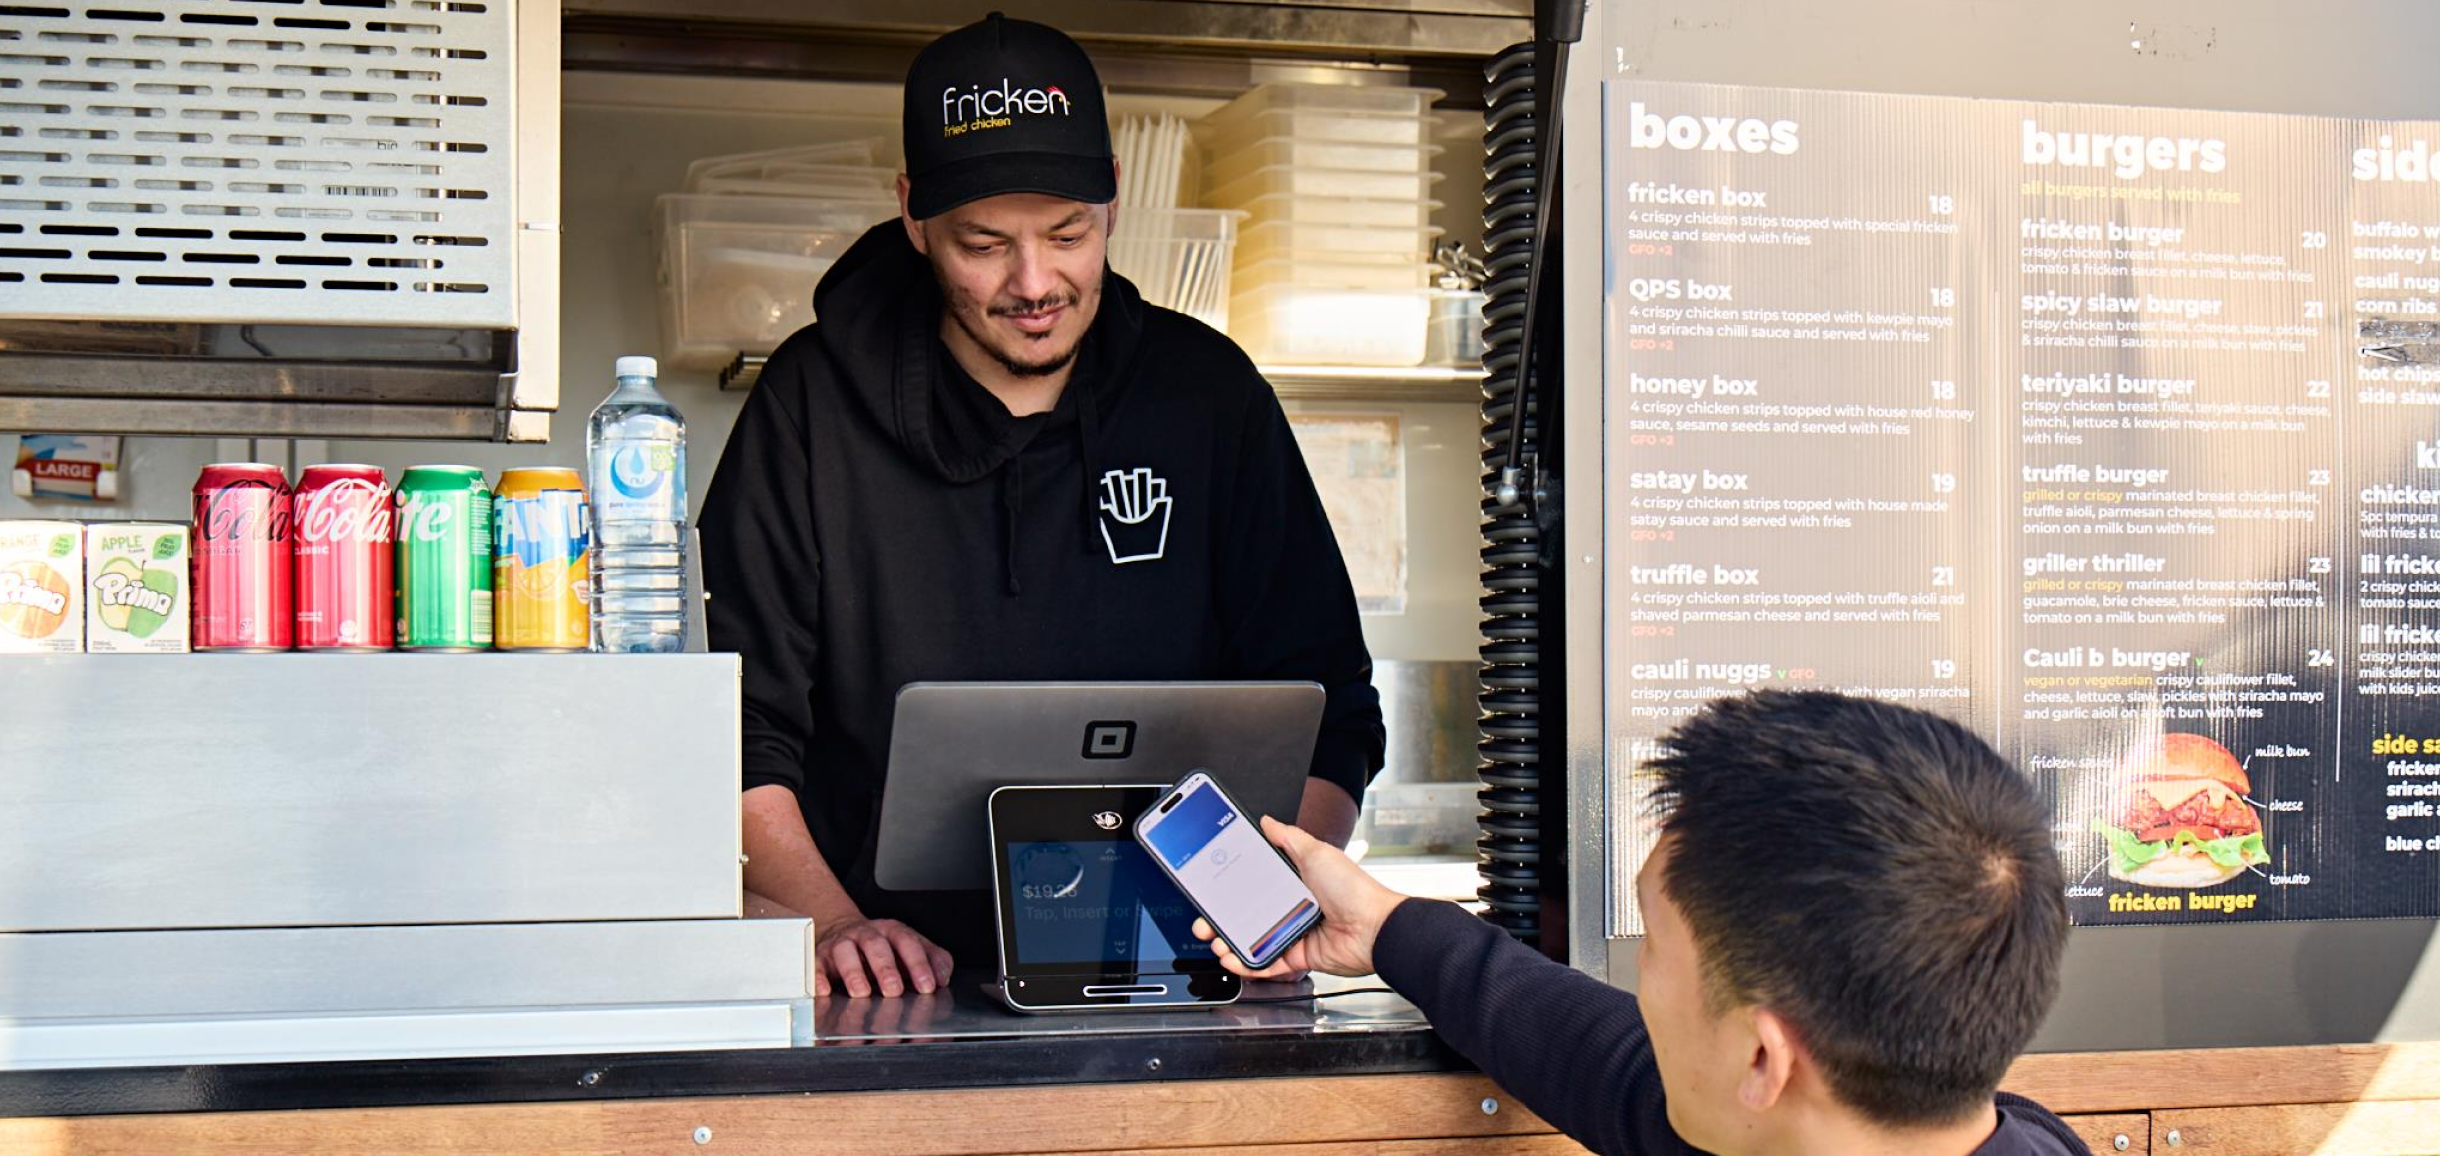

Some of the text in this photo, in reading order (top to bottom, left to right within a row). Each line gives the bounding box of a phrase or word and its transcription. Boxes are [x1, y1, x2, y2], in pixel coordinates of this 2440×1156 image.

[943, 78, 1068, 125] fricken
[944, 117, 1011, 137] fried chicken
[1630, 102, 1800, 155] boxes
[2022, 120, 2226, 180] burgers
[1628, 183, 1953, 215] fricken box 18
[2021, 182, 2242, 204] all burgers served with fries
[1628, 211, 1958, 234] 4 crispy chicken strips topped with special fricken
[2352, 221, 2419, 238] buffalo
[1628, 229, 1811, 245] sauce and served with fries
[2020, 219, 2327, 248] fricken burger 20
[2352, 245, 2427, 265] smokey
[2354, 273, 2399, 289] cauli
[1629, 279, 1955, 307] QPS box 18
[2021, 292, 2323, 318] spicy slaw burger 21
[2355, 297, 2437, 314] corn ribs
[2357, 364, 2389, 381] hot
[1630, 373, 1956, 400] honey box 18
[2021, 372, 2330, 398] teriyaki burger 22
[2357, 388, 2395, 404] side
[35, 462, 93, 478] LARGE
[2022, 463, 2330, 486] truffle burger 23
[1630, 469, 1956, 494] satay box 19
[304, 478, 392, 543] Cola
[2360, 510, 2438, 525] 5pc tempura
[2023, 521, 2215, 535] onion on a milk bun with fries
[2360, 526, 2428, 539] with fries &
[102, 534, 143, 551] APPLE
[2023, 552, 2331, 574] griller thriller 23
[2360, 554, 2380, 574] lil
[1630, 564, 1954, 586] truffle box 21
[94, 572, 173, 616] Prima
[2360, 581, 2369, 593] 2
[2370, 581, 2407, 596] crispy
[2360, 596, 2405, 609] tomato
[1630, 608, 1940, 624] shaved parmesan cheese and served with fries
[2360, 624, 2380, 644] lil
[2023, 647, 2083, 667] Cauli
[2089, 647, 2104, 667] b
[2112, 647, 2191, 670] burger
[2308, 649, 2334, 667] 24
[2359, 650, 2396, 665] crispy
[1631, 659, 1689, 679] cauli
[1696, 664, 1771, 684] nuggs
[1932, 659, 1956, 679] 19
[2023, 673, 2297, 689] vegan or vegetarian crispy cauliflower fillet,
[2359, 666, 2421, 678] milk slider
[2359, 682, 2387, 695] with
[2389, 682, 2414, 695] kids
[2255, 744, 2310, 758] milk bun
[2372, 733, 2418, 754] side
[2030, 756, 2075, 770] fricken
[2269, 800, 2303, 812] cheese
[2386, 800, 2433, 820] garlic
[1217, 812, 1235, 827] VISA
[2385, 835, 2423, 852] blue
[2270, 873, 2310, 885] tomato
[1026, 905, 1059, 921] Tap,
[1064, 904, 1109, 919] Insert
[1114, 906, 1130, 917] or
[2109, 892, 2256, 913] fricken burger
